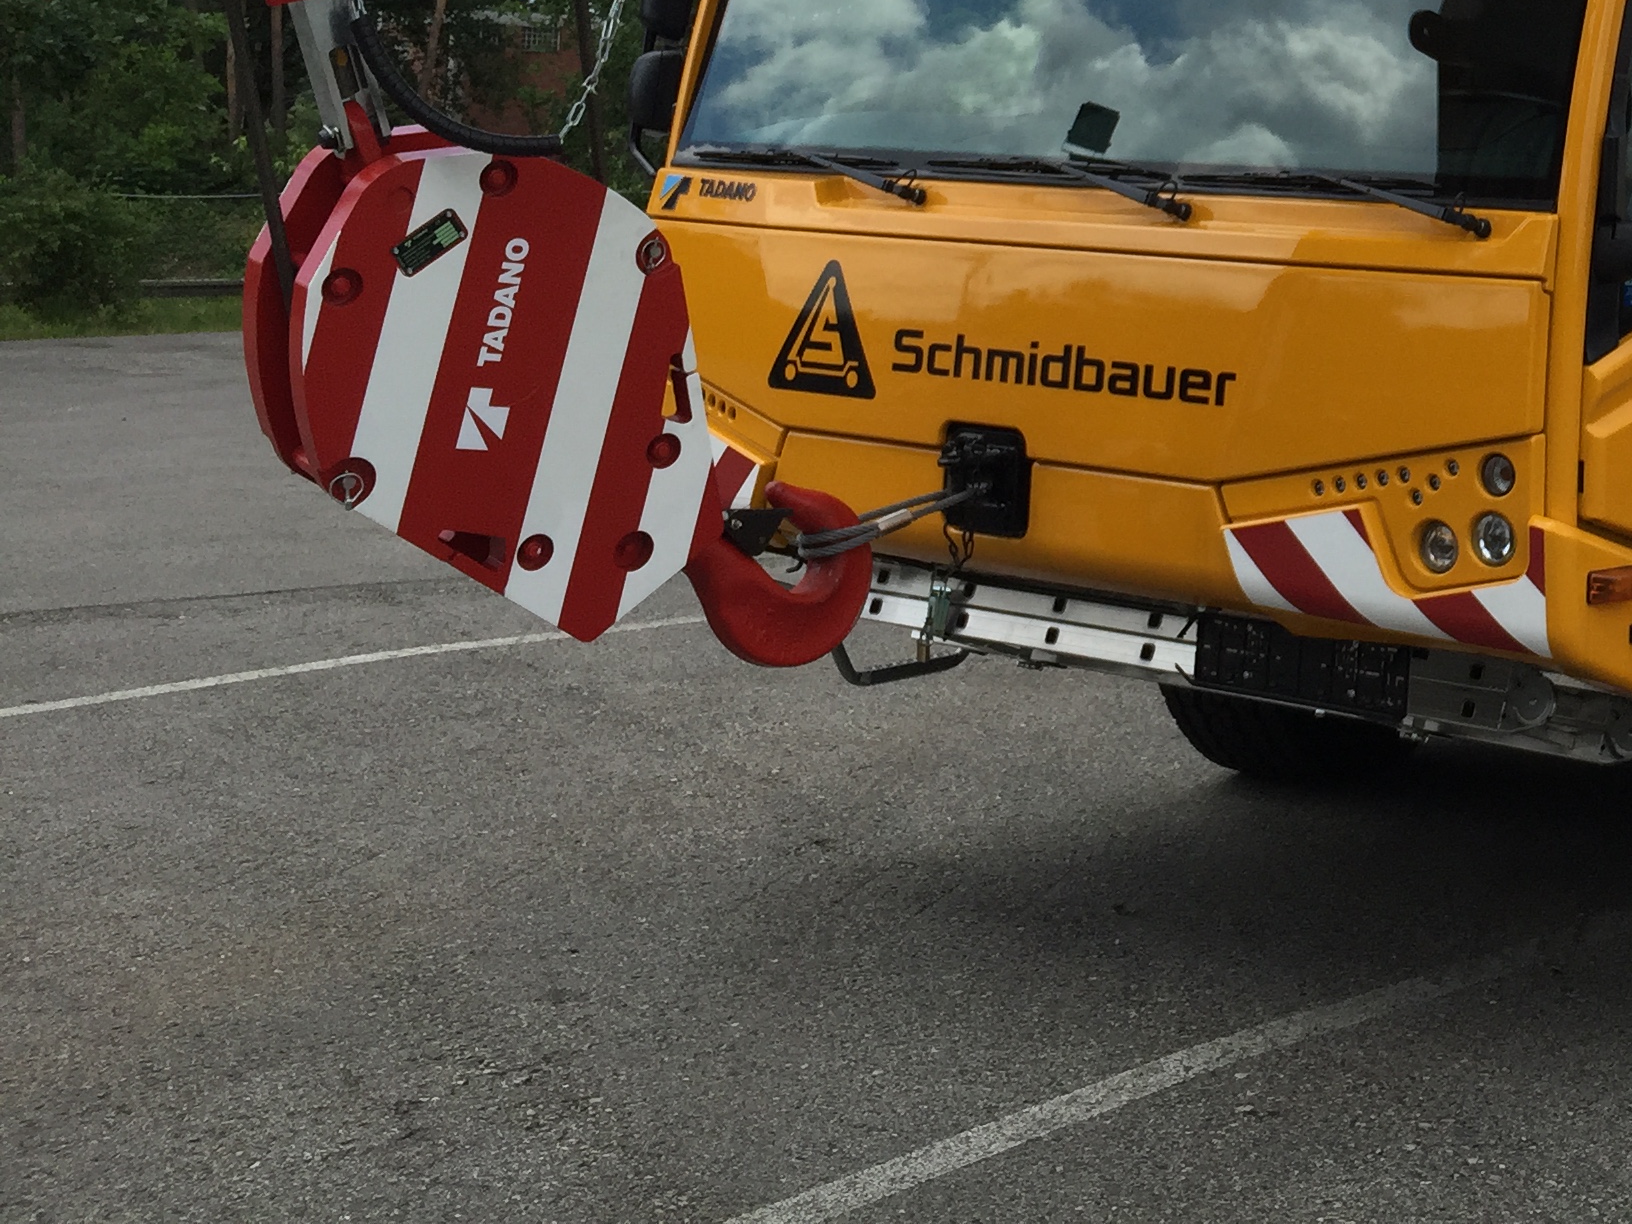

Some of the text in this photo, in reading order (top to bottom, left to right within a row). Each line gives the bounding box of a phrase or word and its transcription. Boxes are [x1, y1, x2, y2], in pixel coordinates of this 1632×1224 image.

[699, 178, 757, 202] TADANO
[477, 237, 530, 367] TADANO
[892, 329, 1236, 406] Schmidbauer
